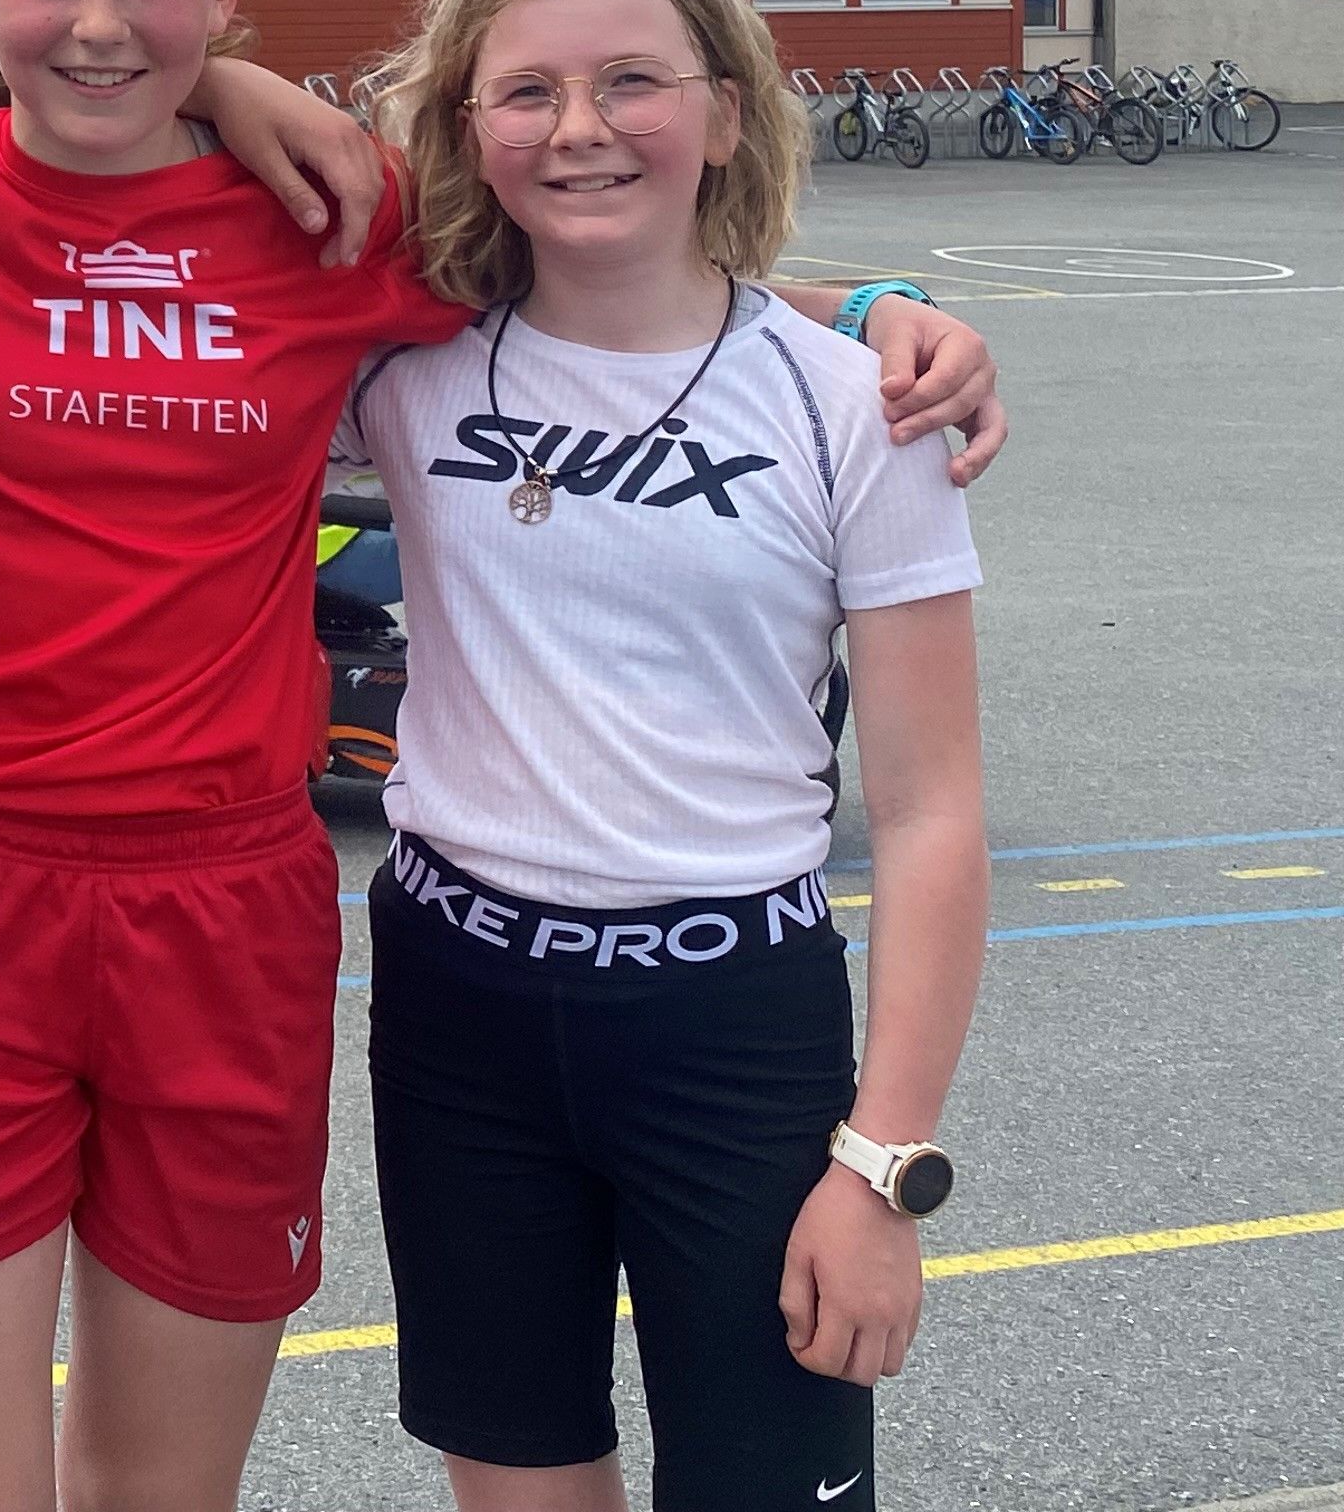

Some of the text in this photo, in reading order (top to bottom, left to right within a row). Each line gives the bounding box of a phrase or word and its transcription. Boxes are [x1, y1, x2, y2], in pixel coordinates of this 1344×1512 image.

[32, 298, 245, 361] TINE
[8, 384, 269, 434] STAFETTEN
[387, 828, 520, 949] NIKE
[528, 912, 739, 968] PRO
